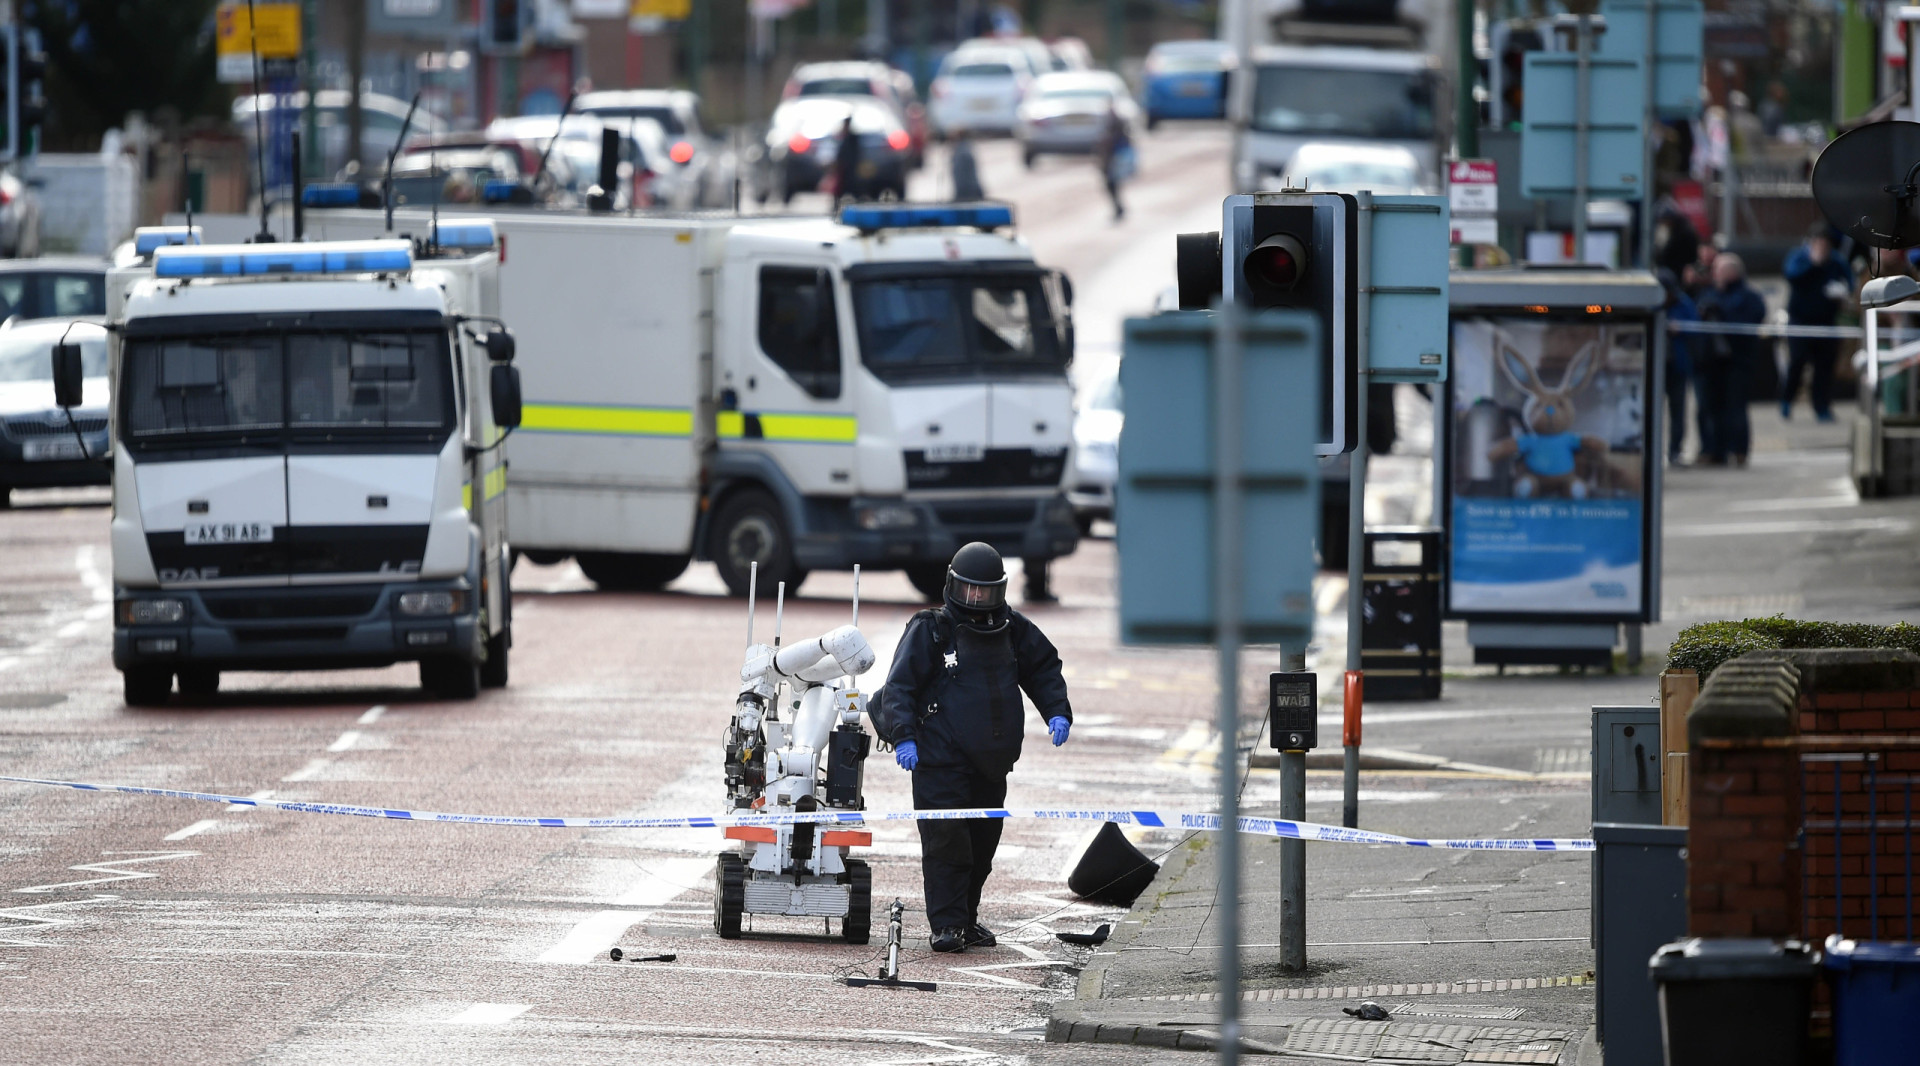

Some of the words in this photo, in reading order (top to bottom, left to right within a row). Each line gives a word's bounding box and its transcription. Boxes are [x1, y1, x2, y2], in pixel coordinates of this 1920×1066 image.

[198, 525, 217, 542] AX
[222, 524, 236, 541] 91
[159, 567, 221, 582] DAF
[1182, 814, 1206, 828] POLICE
[1207, 816, 1223, 829] LINE
[1248, 818, 1271, 833] CROSS
